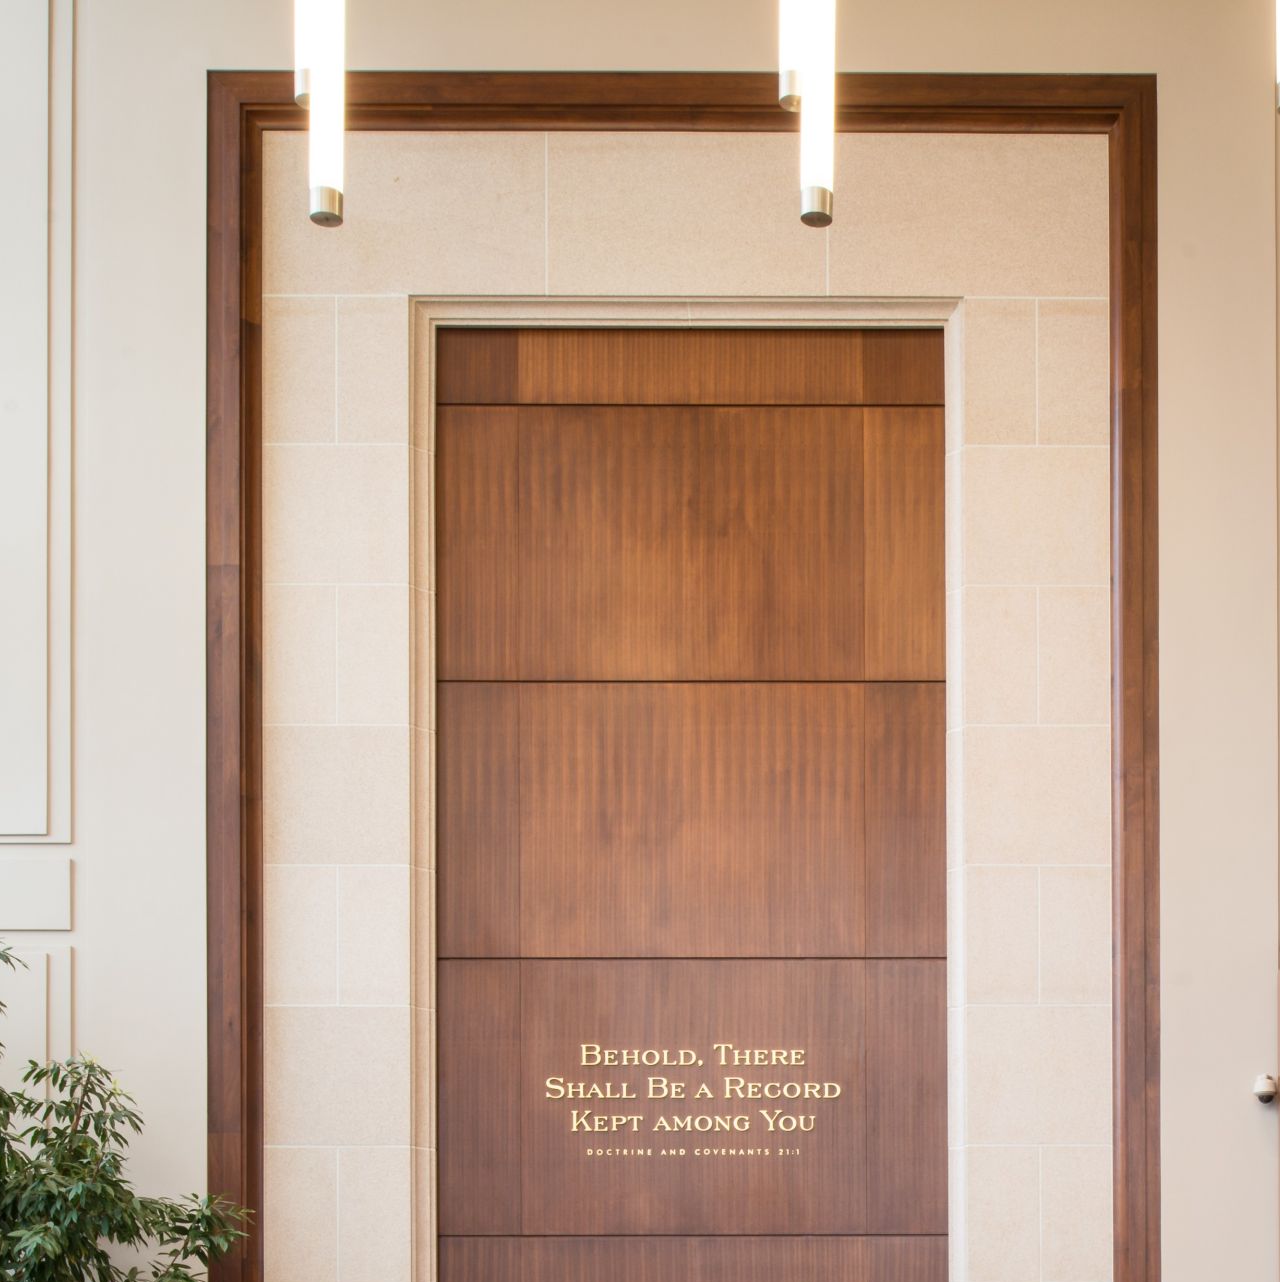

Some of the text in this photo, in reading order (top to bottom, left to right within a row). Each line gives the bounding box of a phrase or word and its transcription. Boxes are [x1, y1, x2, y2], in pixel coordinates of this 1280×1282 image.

[580, 1043, 806, 1067] BEHOLD, THERE
[545, 1076, 842, 1099] SHALL BE A RECORD
[570, 1110, 817, 1132] KEPT AMONG YOU
[586, 1148, 801, 1156] DOCTRINE AND COVENANTS 21:1
